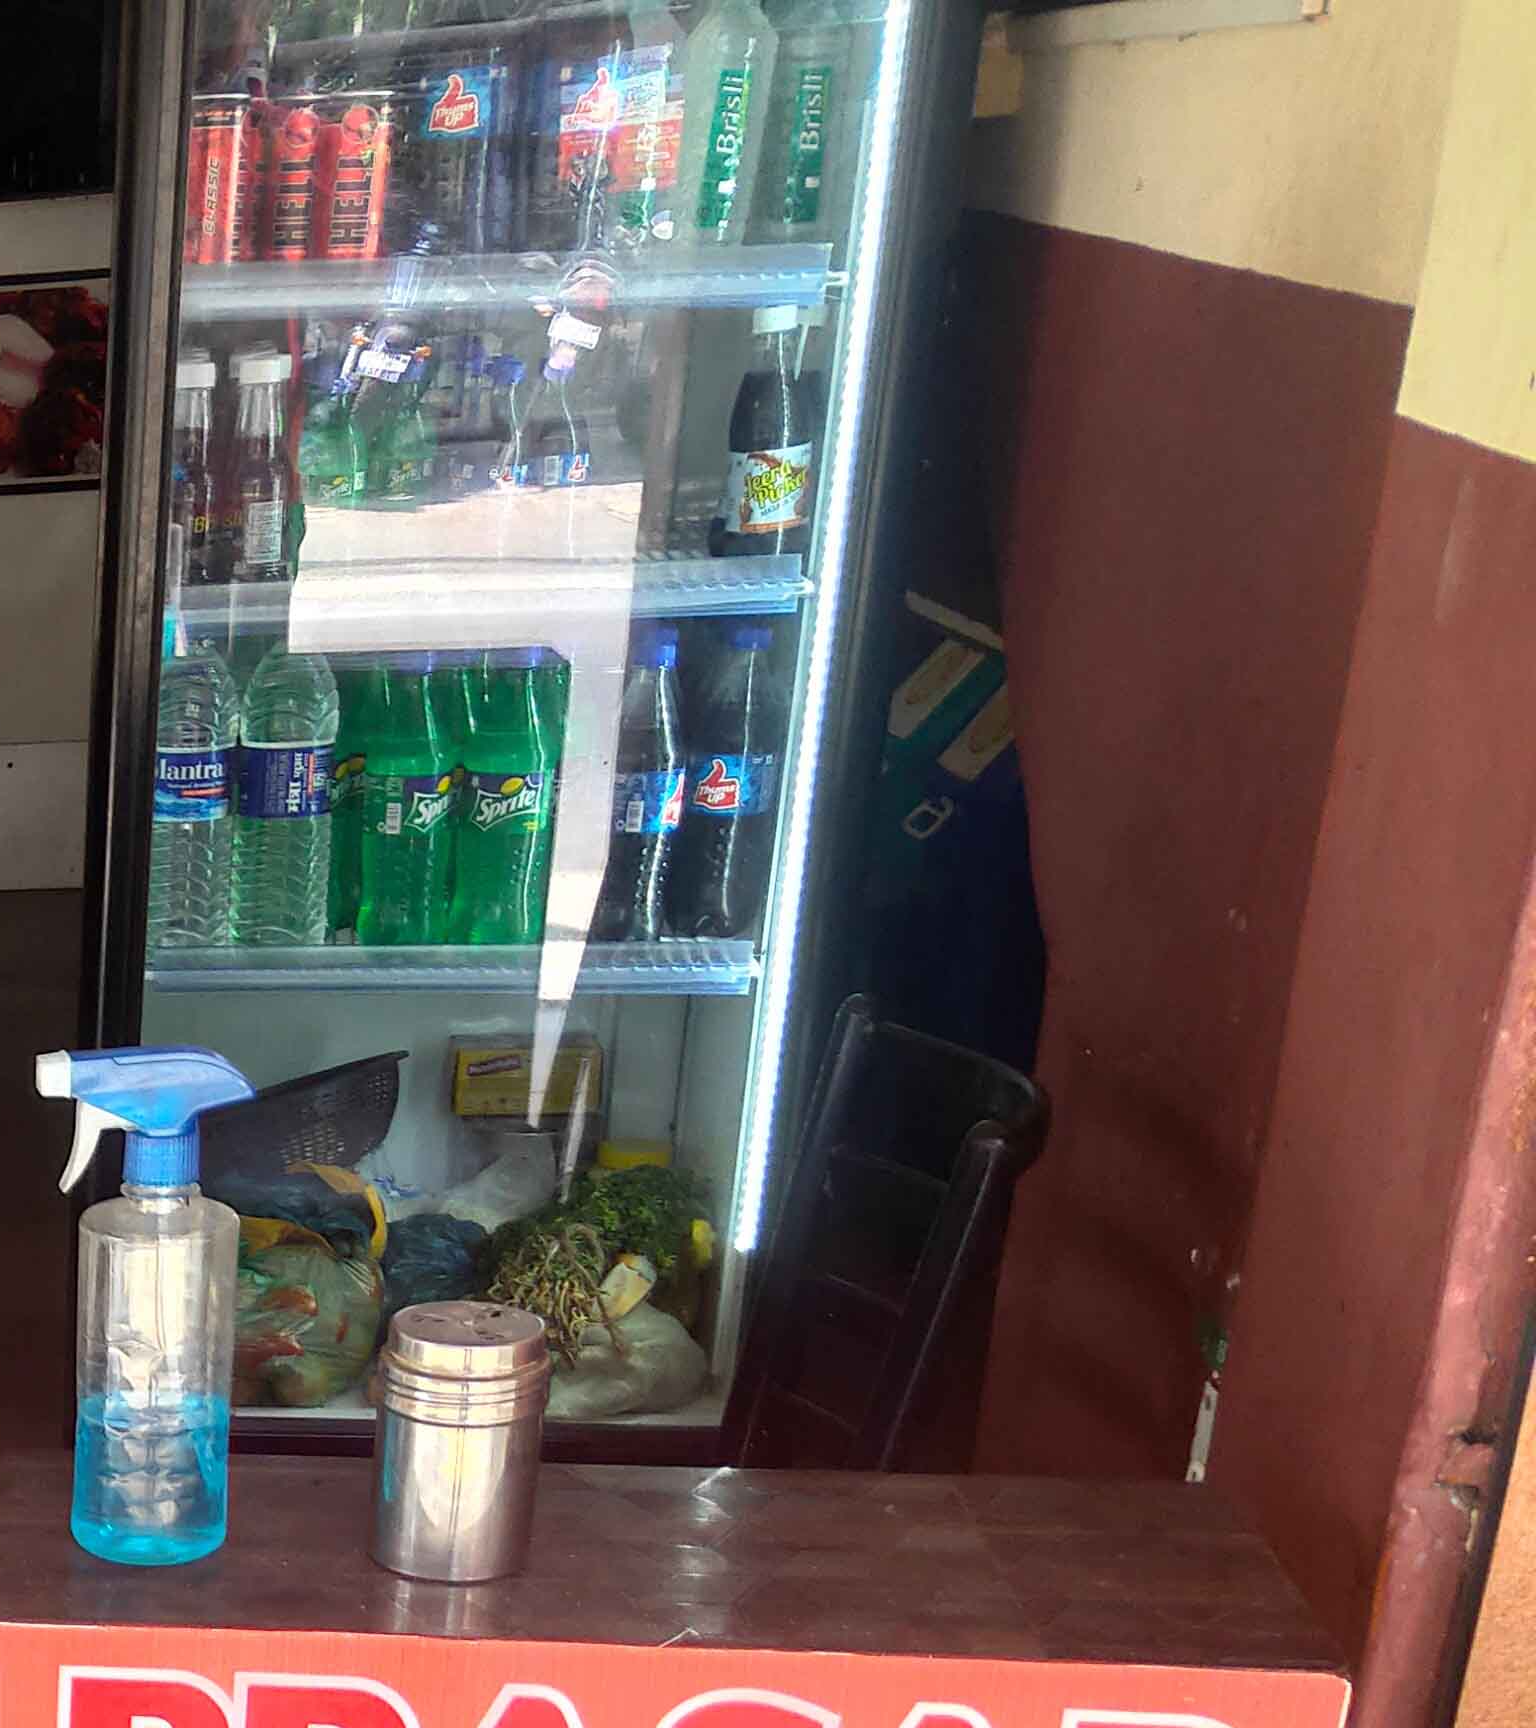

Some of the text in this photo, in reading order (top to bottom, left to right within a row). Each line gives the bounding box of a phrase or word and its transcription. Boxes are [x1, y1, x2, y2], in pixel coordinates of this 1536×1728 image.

[717, 75, 743, 153] Brisli
[800, 74, 823, 150] Brisli
[329, 154, 374, 247] HELL
[476, 785, 535, 824] Sprite
